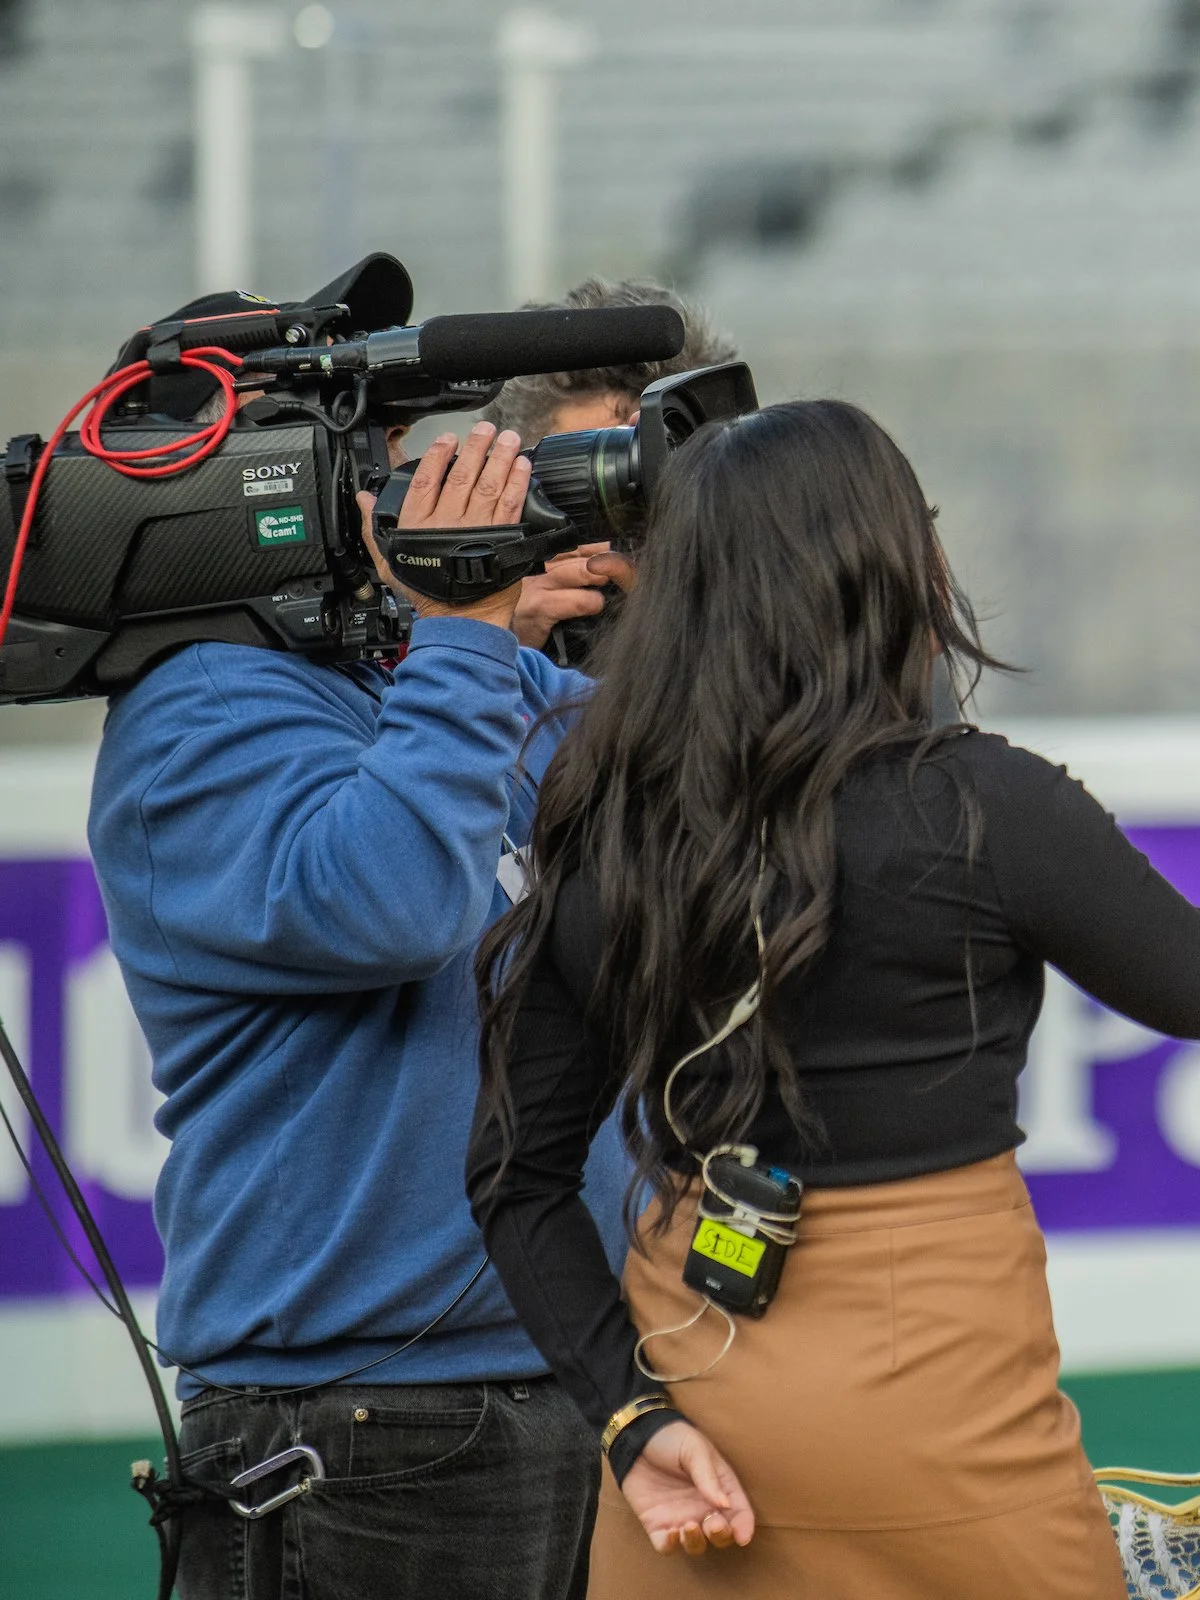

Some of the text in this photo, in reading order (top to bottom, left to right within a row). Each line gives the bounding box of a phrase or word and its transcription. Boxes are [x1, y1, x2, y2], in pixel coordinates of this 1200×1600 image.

[242, 462, 302, 481] SONY
[272, 525, 297, 538] cam1
[396, 553, 441, 568] Canon
[701, 1228, 755, 1269] SIDE
